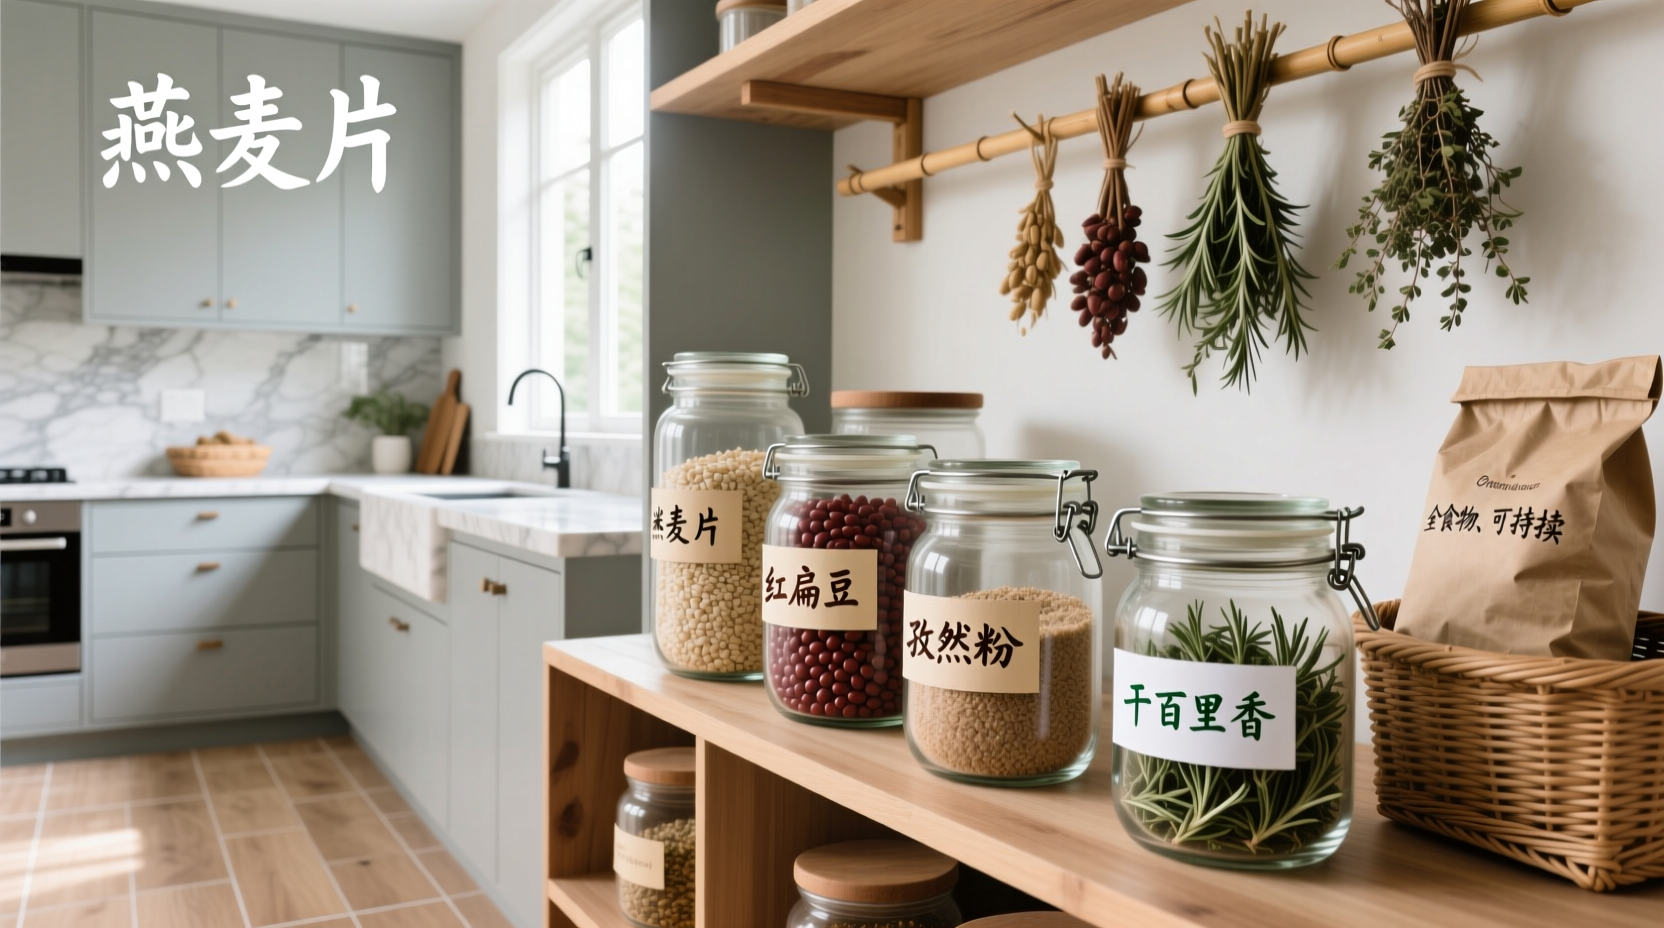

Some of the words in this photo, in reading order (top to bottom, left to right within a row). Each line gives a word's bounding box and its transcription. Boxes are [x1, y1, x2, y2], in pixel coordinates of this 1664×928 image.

[765, 565, 859, 610] 红扁豆
[906, 618, 1024, 669] 孜然粉
[1124, 684, 1276, 741] 干百里香
